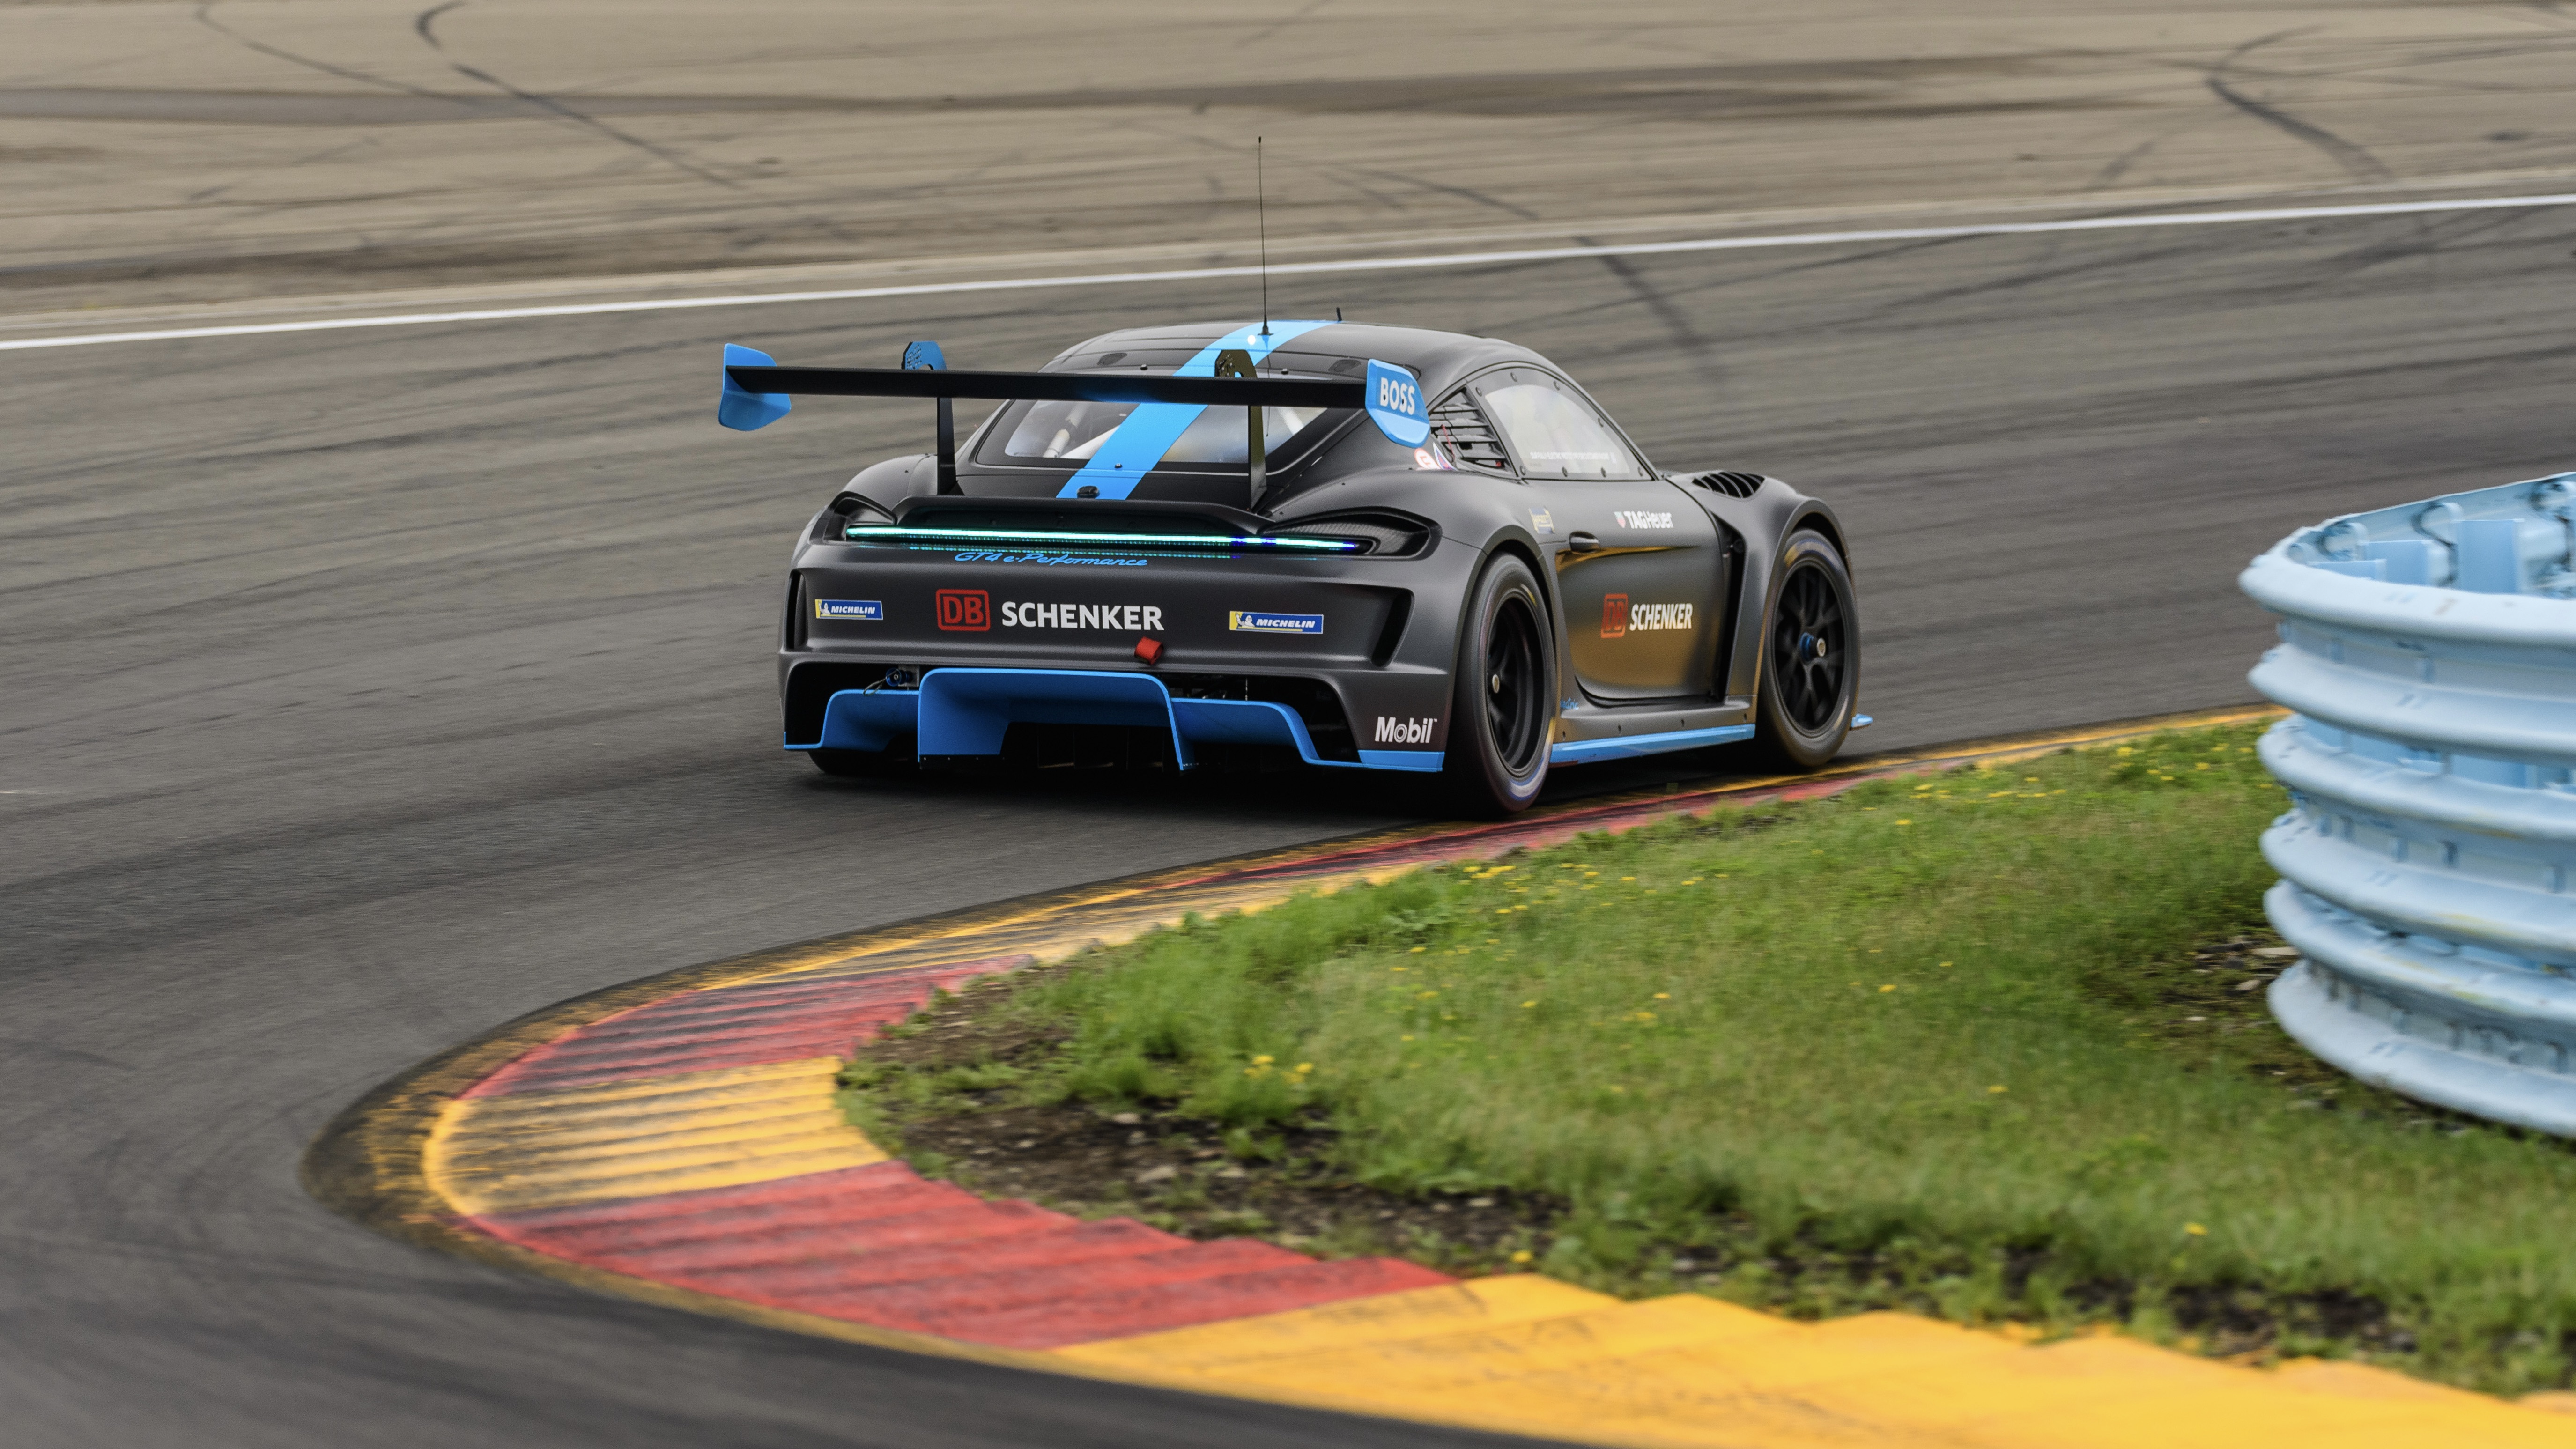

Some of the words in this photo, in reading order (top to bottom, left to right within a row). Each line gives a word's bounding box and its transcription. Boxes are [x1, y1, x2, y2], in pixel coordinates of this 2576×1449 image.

[1380, 377, 1415, 415] BOSS
[955, 552, 1003, 562] GT4
[1003, 553, 1147, 566] e-Performance
[831, 606, 875, 614] MICHELIN
[942, 596, 983, 624] DB
[1001, 601, 1164, 630] SCHENKER
[1256, 619, 1316, 628] MICHELIN
[1606, 601, 1624, 630] DB
[1629, 603, 1693, 631] SCHENKER
[1375, 716, 1433, 743] Mobil
